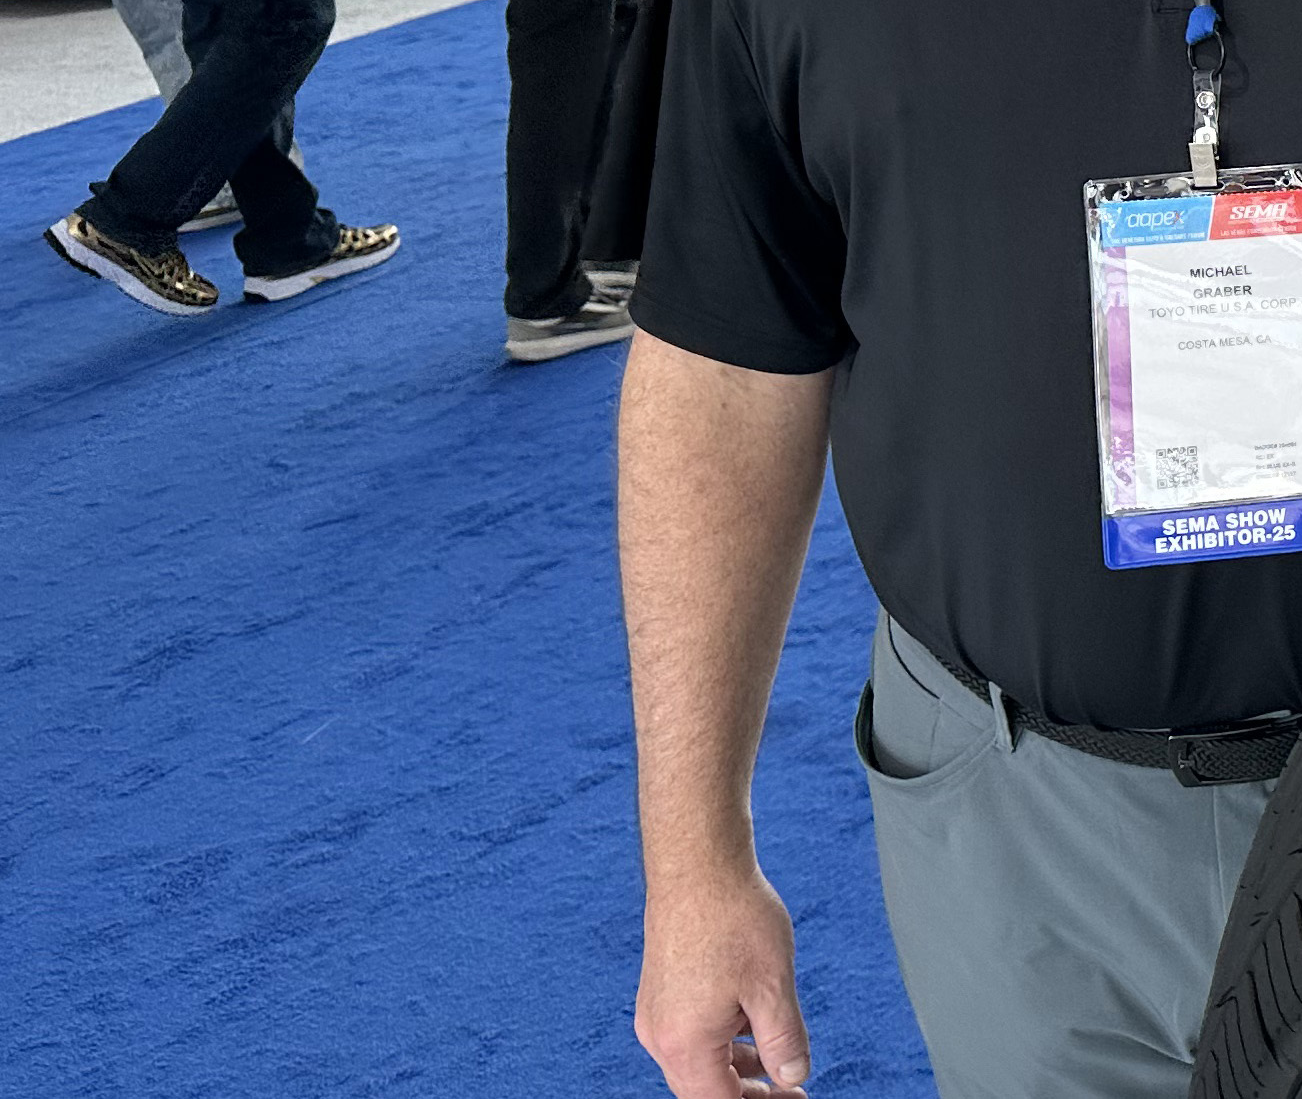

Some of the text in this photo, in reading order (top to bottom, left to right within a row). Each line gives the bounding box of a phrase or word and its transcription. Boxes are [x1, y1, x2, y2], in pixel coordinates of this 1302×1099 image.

[1229, 203, 1288, 220] SEMA
[1127, 210, 1185, 232] aapex
[1189, 264, 1253, 280] MICHAEL
[1193, 284, 1253, 300] GRABER
[1148, 305, 1185, 319] TOYO
[1187, 302, 1217, 316] TIRE
[1177, 338, 1217, 351] COSTA
[1256, 334, 1272, 345] CA
[1162, 508, 1287, 536] SEMA SHOW
[1155, 525, 1297, 554] EXHIBITOR-25
